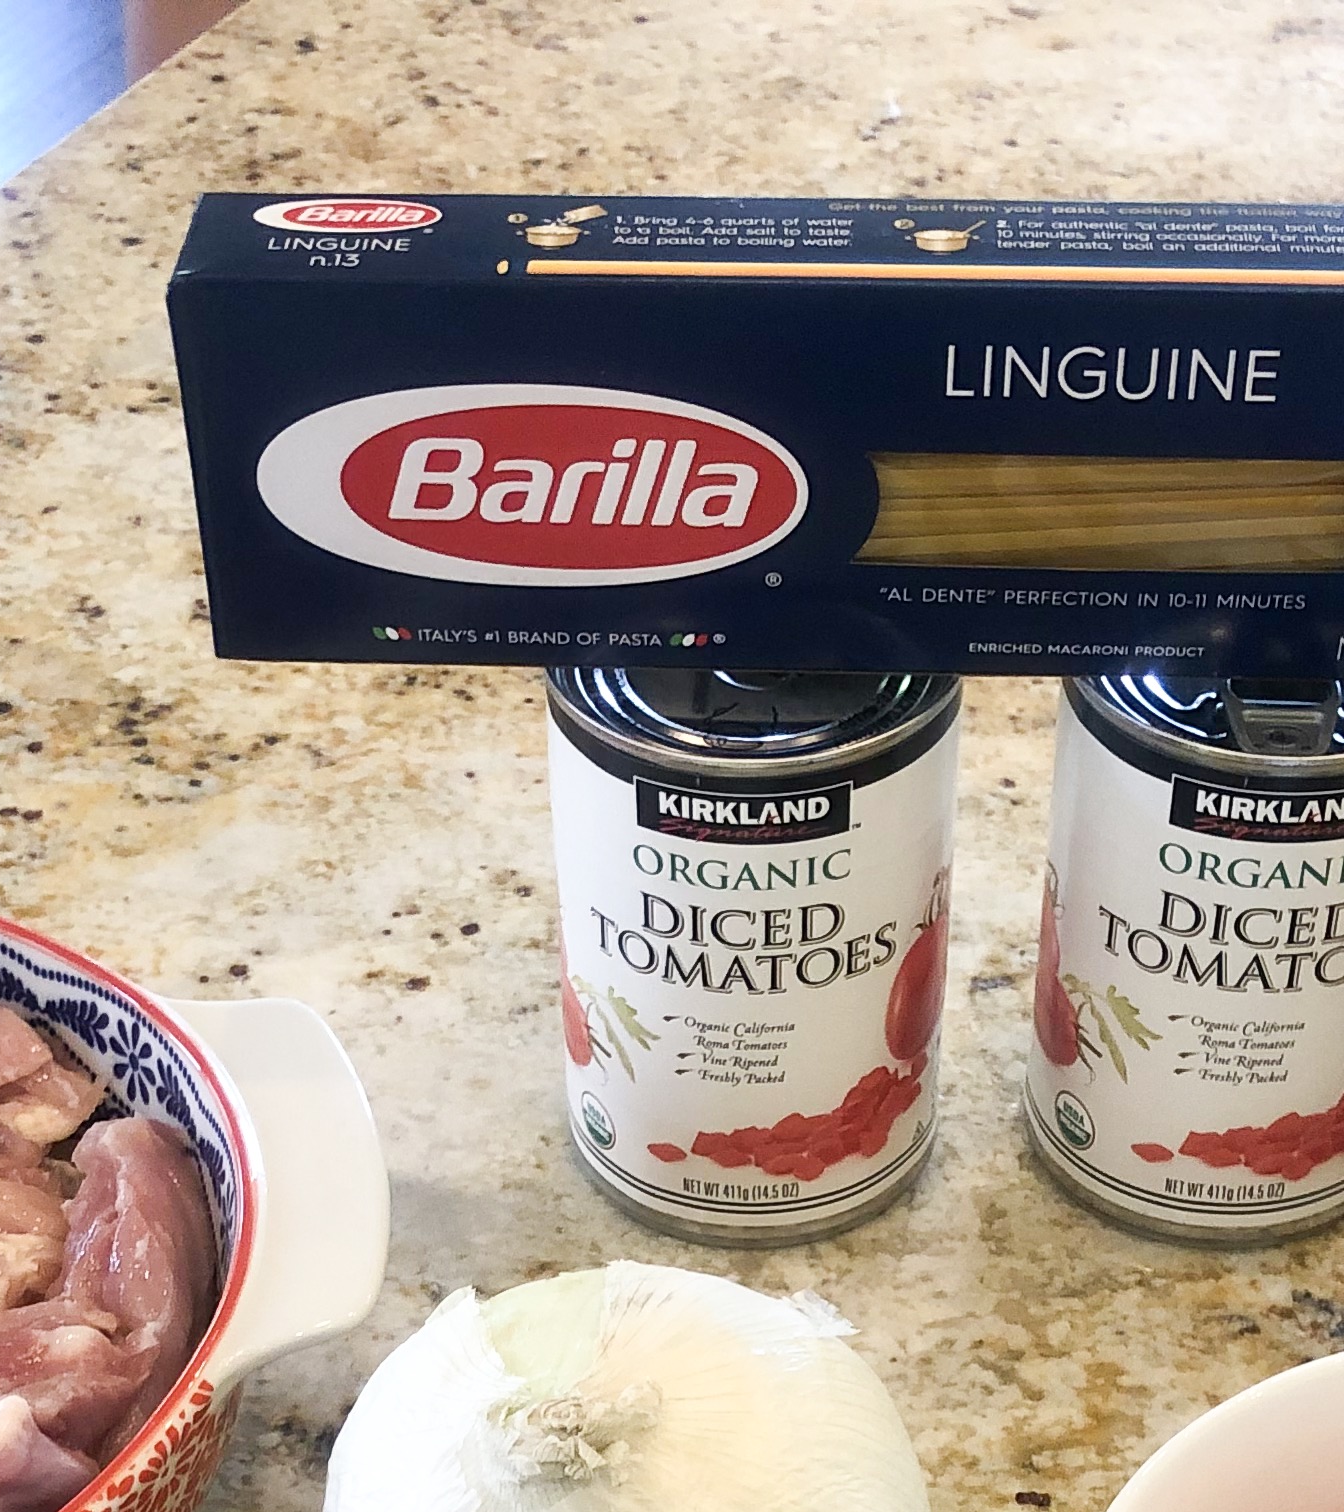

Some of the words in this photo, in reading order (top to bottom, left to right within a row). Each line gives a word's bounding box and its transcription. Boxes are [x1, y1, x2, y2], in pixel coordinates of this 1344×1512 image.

[297, 206, 426, 223] Barilla
[955, 204, 995, 213] from
[1004, 205, 1043, 214] your
[614, 226, 631, 234] to
[702, 226, 738, 235] Add
[746, 226, 776, 236] salt
[784, 227, 801, 236] to
[634, 216, 678, 227] Bring
[685, 216, 714, 225] 4-6
[720, 217, 775, 227] quarts
[782, 217, 800, 226] of
[807, 218, 854, 227] water
[1018, 219, 1046, 229] For
[1051, 220, 1128, 230] authentic
[1225, 223, 1278, 233] pasta,
[1285, 224, 1316, 233] boil
[267, 237, 412, 252] LINGUINE
[613, 236, 649, 245] Add
[656, 237, 705, 247] pasta
[713, 237, 731, 246] to
[738, 237, 795, 248] boiling
[803, 238, 853, 247] water.
[996, 239, 1051, 249] tender
[1060, 240, 1113, 250] pasta,
[1122, 241, 1154, 251] boil
[1162, 243, 1185, 251] an
[1194, 242, 1281, 252] additional
[1093, 231, 1150, 241] stirring
[309, 253, 360, 267] n.13
[945, 345, 1282, 403] LINGUINE
[387, 437, 759, 528] Barilla
[879, 587, 913, 602] "AL
[922, 588, 995, 604] DENTE"
[1004, 590, 1128, 607] PERFECTION
[1137, 593, 1158, 607] IN
[1168, 593, 1208, 608] 10-11
[1216, 594, 1306, 610] MINUTES
[418, 628, 477, 643] ITALY'S
[484, 630, 500, 643] #1
[508, 631, 570, 645] BRAND
[576, 632, 601, 646] OF
[608, 632, 662, 647] PASTA
[968, 642, 1043, 655] ENRICHED
[1048, 644, 1129, 657] MACARONI
[1134, 645, 1206, 658] PRODUCT
[658, 791, 830, 825] KIRKLAND
[633, 844, 852, 891] ORGANIC
[640, 892, 846, 950] DICED
[591, 906, 897, 994] TOMATOES
[684, 1016, 730, 1033] Organic
[733, 1022, 796, 1037] California
[1191, 1015, 1239, 1033] Organic
[1242, 1020, 1306, 1037] California
[693, 1035, 730, 1050] Roma
[732, 1039, 788, 1051] Tomatoes
[1198, 1034, 1236, 1049] Roma
[1238, 1038, 1296, 1050] Tomatoes
[701, 1052, 727, 1066] Vine
[728, 1054, 779, 1071] Ripened
[1204, 1051, 1231, 1065] Vine
[1233, 1053, 1284, 1070] Ripened
[697, 1069, 742, 1087] Freshly
[744, 1070, 786, 1084] Packed
[1198, 1068, 1243, 1087] Freshly
[1245, 1069, 1288, 1084] Packed
[683, 1177, 701, 1194] NET
[703, 1182, 720, 1197] WT
[723, 1184, 749, 1201] 411g
[752, 1184, 779, 1201] (14.5
[781, 1182, 799, 1198] OZ)
[1164, 1178, 1184, 1195] NET
[1187, 1182, 1204, 1198] WT
[1207, 1184, 1234, 1201] 411g
[1237, 1184, 1264, 1201] (14.5
[1267, 1182, 1285, 1199] OZ)
